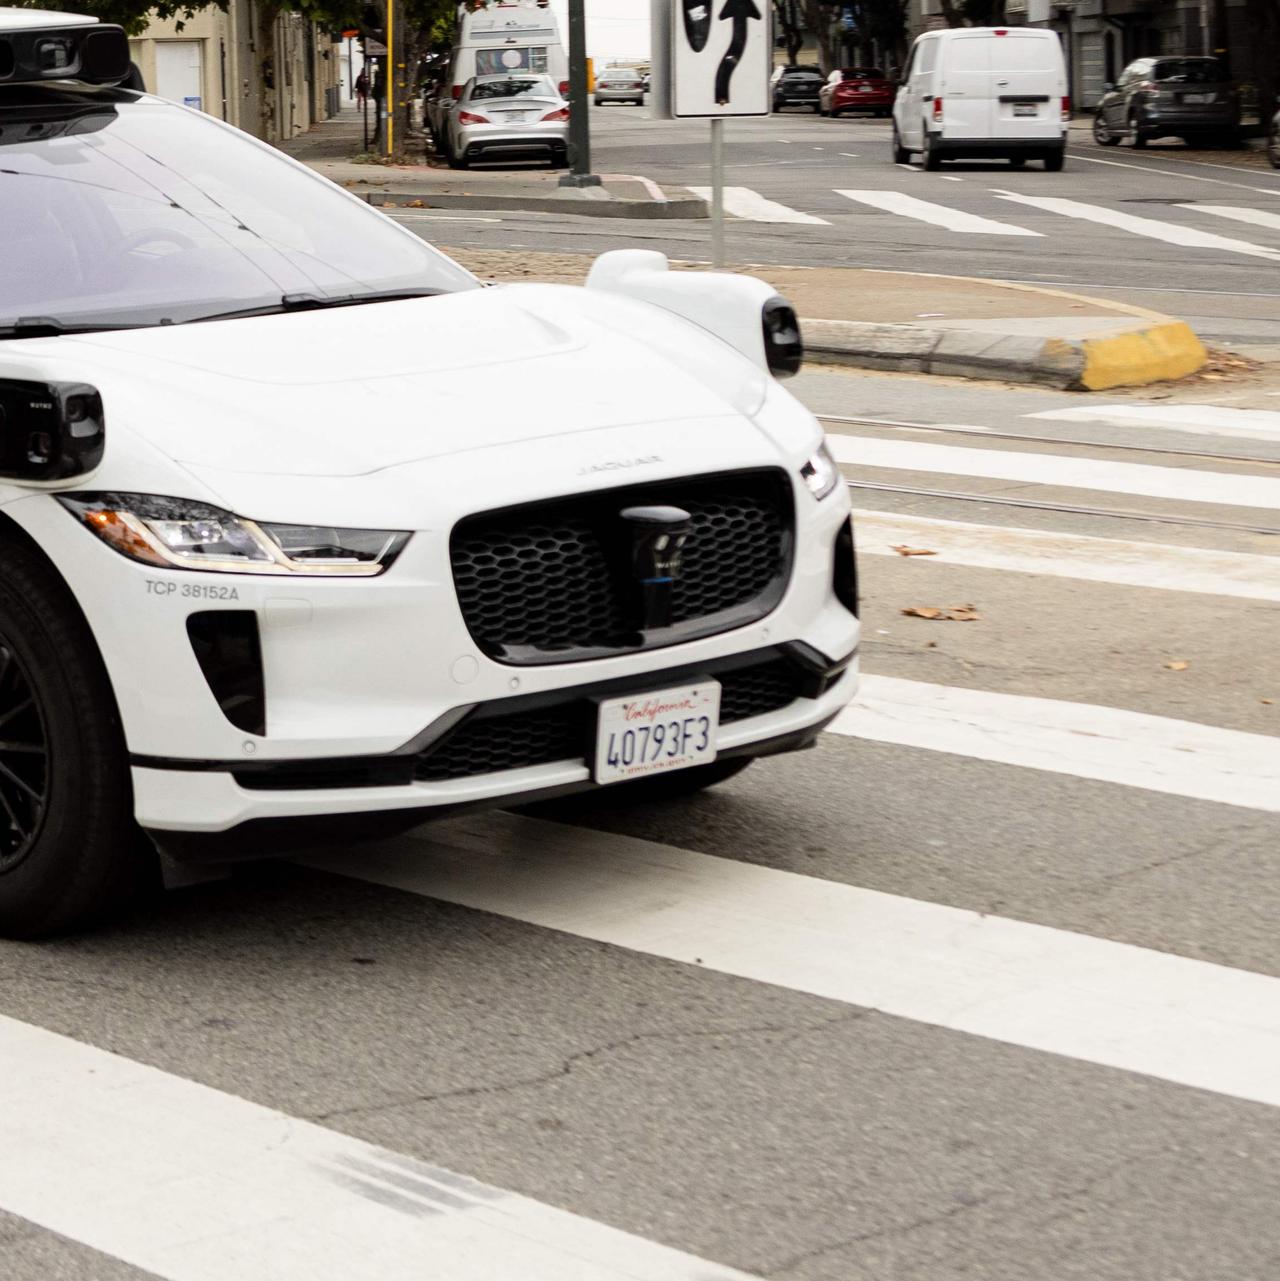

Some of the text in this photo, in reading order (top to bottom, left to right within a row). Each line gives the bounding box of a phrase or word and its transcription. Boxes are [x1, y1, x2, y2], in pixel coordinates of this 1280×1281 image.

[146, 580, 239, 600] TCP 38152A
[607, 716, 710, 768] 40793F3
